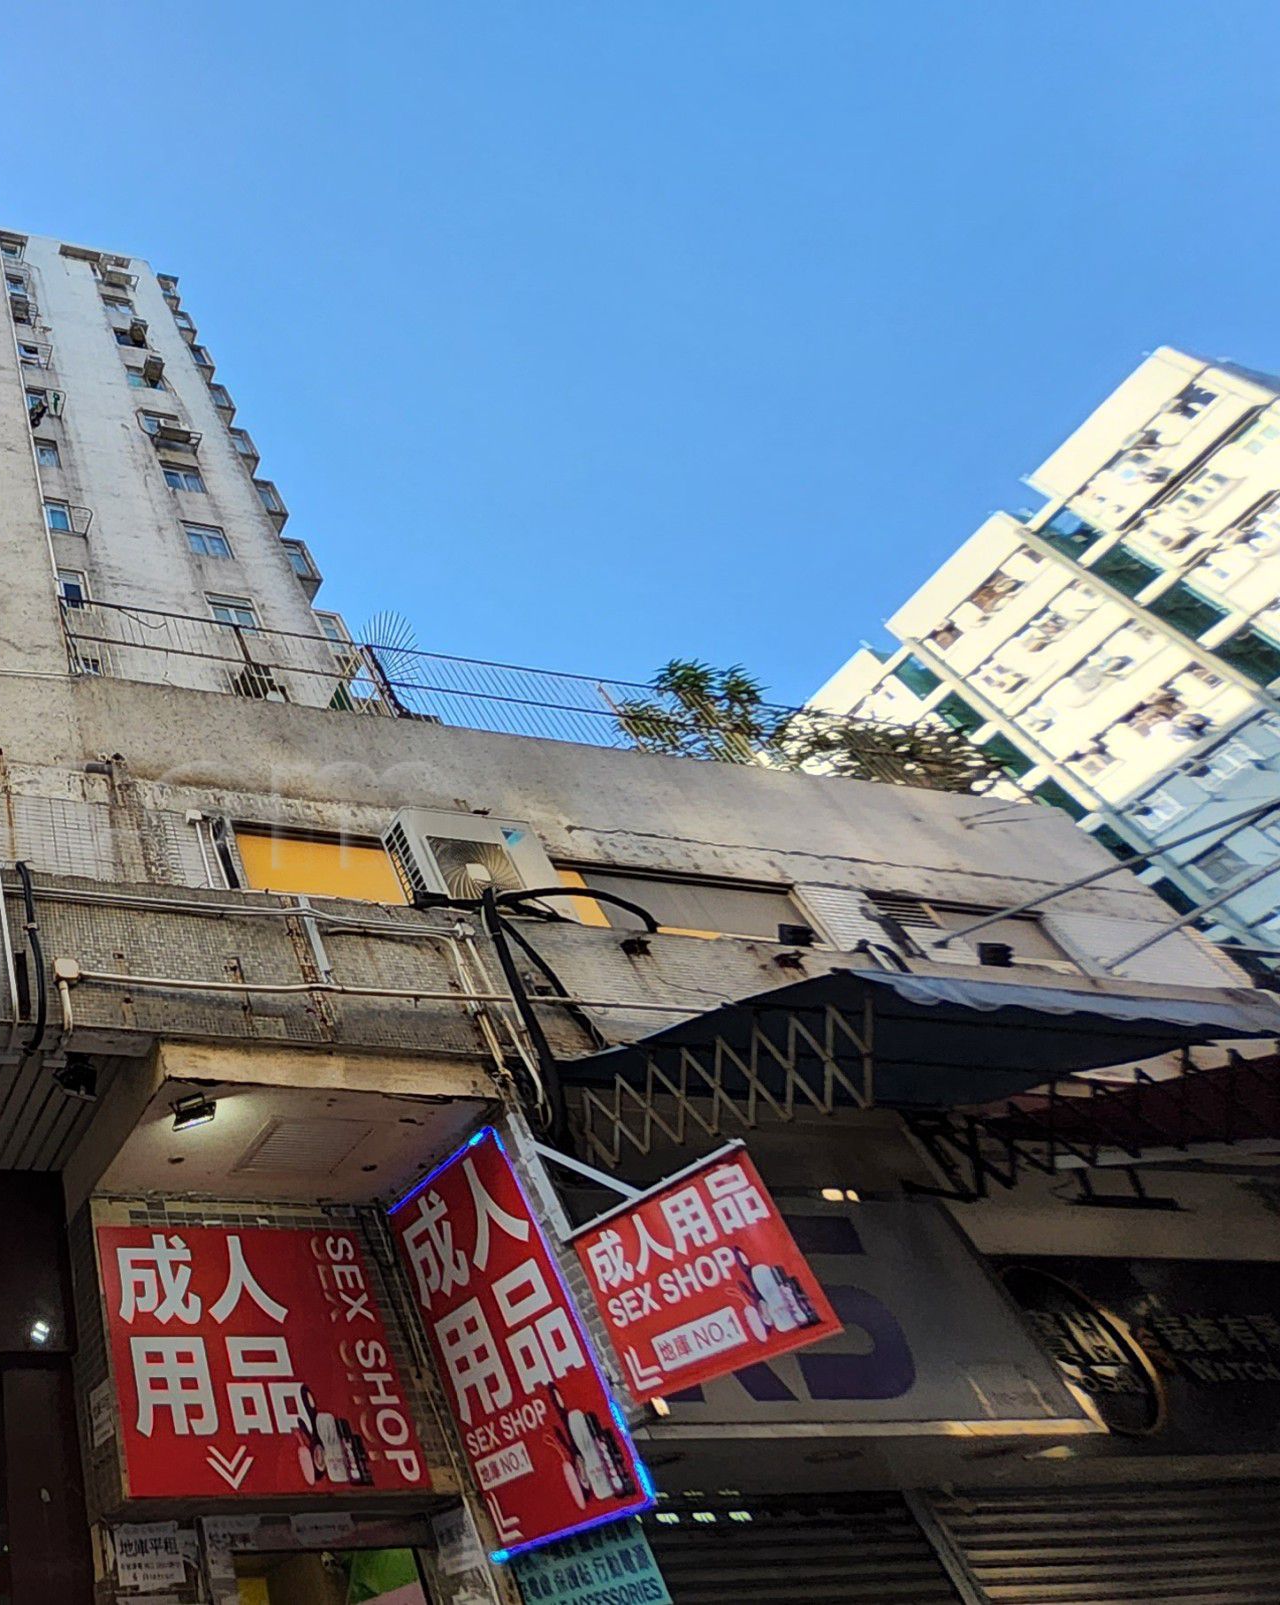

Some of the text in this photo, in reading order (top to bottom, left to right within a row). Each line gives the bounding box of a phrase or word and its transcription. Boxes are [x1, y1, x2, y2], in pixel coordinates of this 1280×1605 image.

[403, 1157, 531, 1309] 成人
[588, 1165, 772, 1293] 成人用品
[115, 1233, 288, 1326] 成人
[607, 1247, 737, 1328] SEX SHOP
[324, 1235, 421, 1483] SEX SHOP
[433, 1258, 588, 1426] 用品
[693, 1314, 741, 1348] NO.1
[129, 1335, 314, 1438] 用品
[465, 1398, 548, 1457] SEX SHOP
[500, 1449, 529, 1475] NO.1
